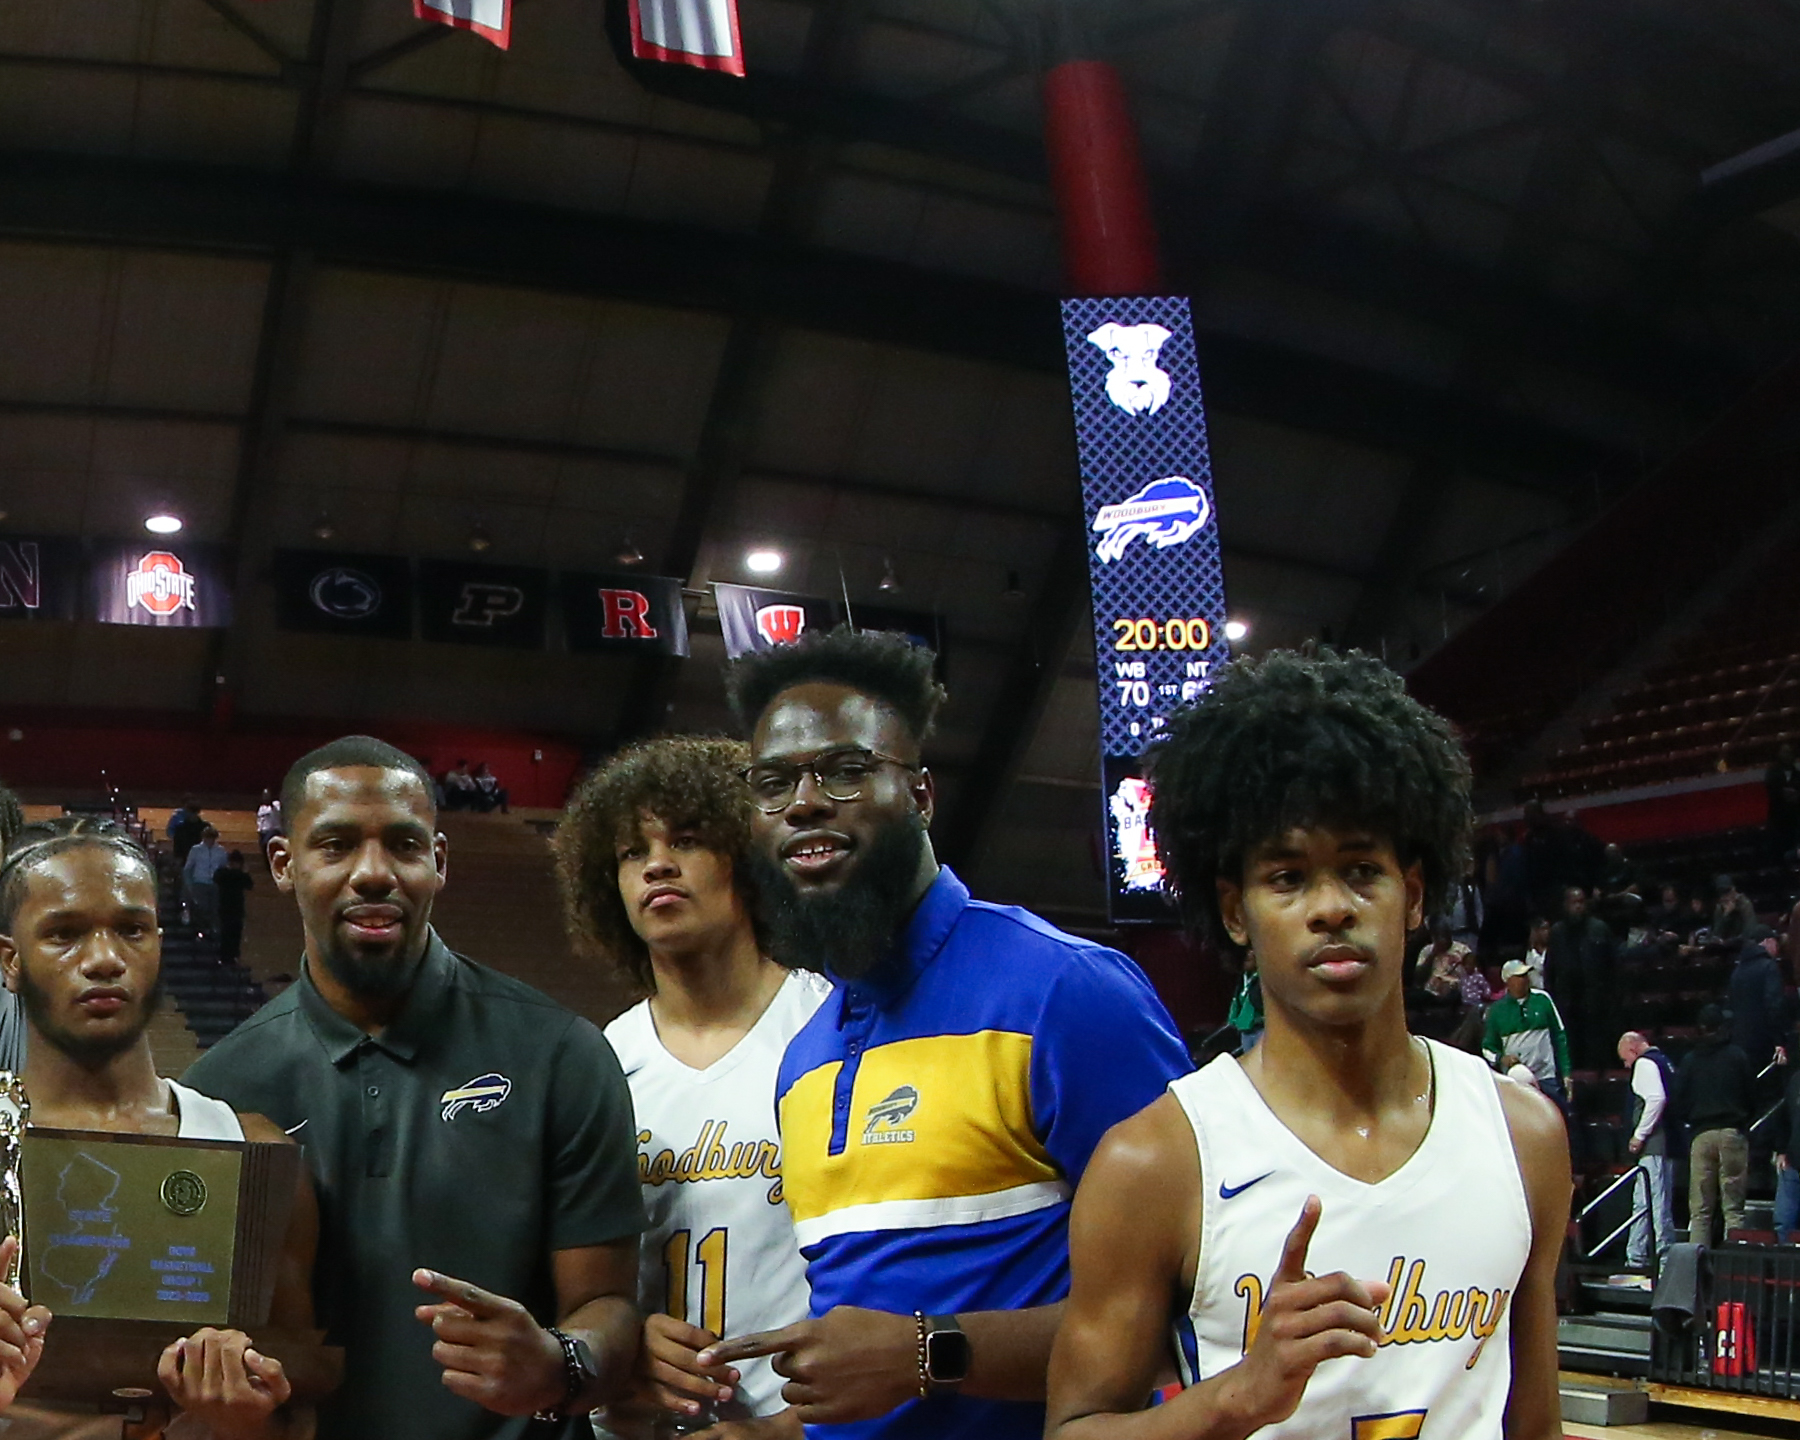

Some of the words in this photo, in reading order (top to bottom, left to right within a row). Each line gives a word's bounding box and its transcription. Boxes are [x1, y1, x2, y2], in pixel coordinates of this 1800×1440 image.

[452, 583, 524, 626] P
[598, 588, 658, 639] R
[1113, 618, 1210, 651] 20:00
[1115, 661, 1146, 678] WB
[1186, 661, 1210, 677] NT
[1117, 681, 1150, 706] 70
[1159, 684, 1178, 695] 1ST
[663, 1226, 728, 1341] 11
